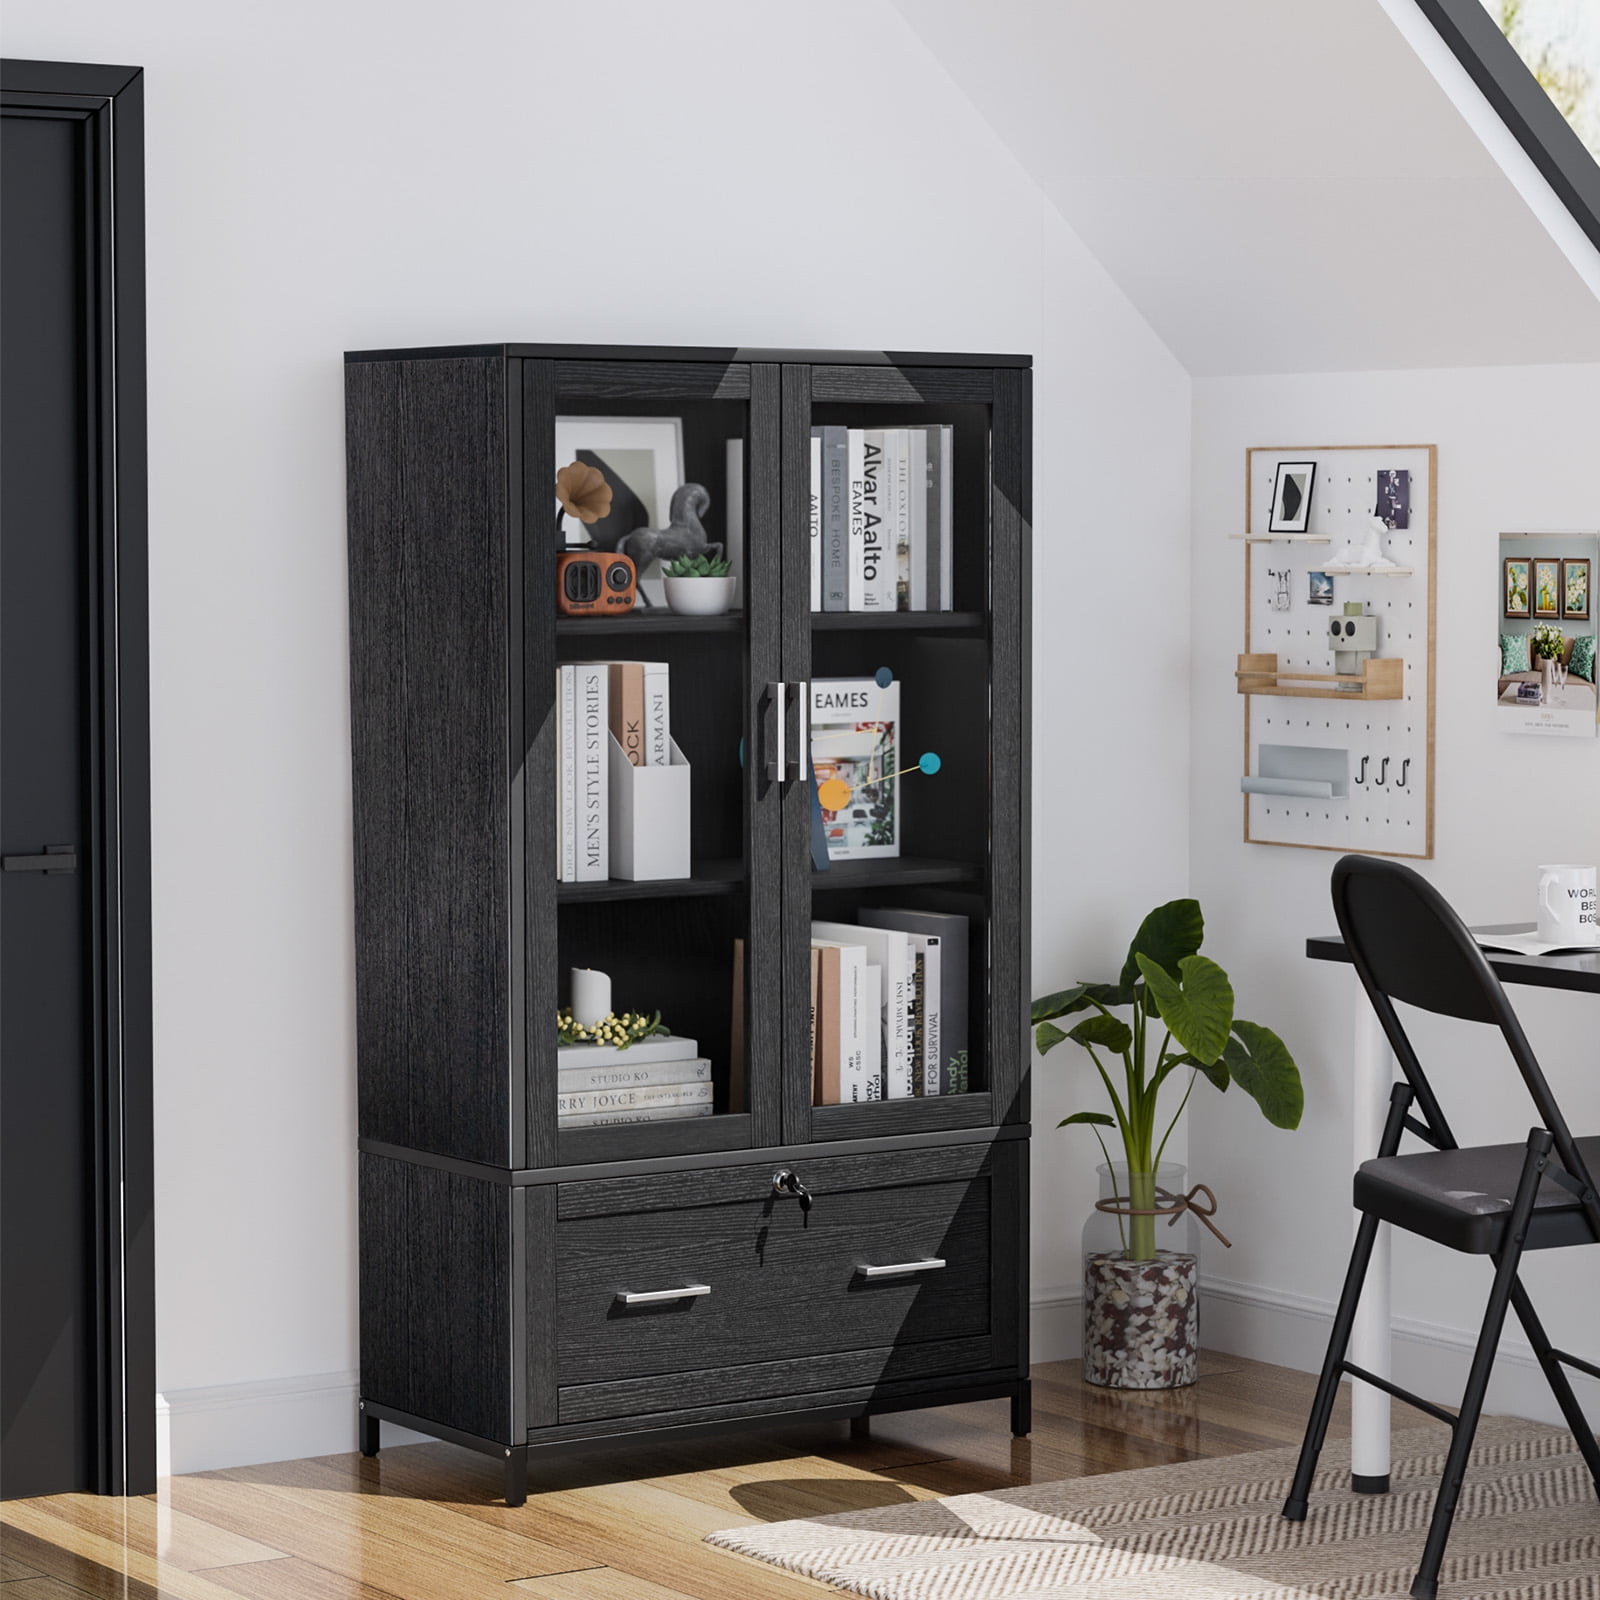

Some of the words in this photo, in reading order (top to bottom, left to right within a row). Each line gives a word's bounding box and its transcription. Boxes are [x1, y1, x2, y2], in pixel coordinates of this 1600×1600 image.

[831, 459, 841, 521] BESPOKE
[864, 443, 882, 506] Alvar
[899, 459, 907, 486] THE
[852, 480, 863, 536] EAMES
[831, 529, 841, 568] HOME
[864, 512, 882, 581] Aalto
[586, 675, 600, 751] STORIES
[815, 692, 869, 709] EAMES
[653, 693, 664, 766] ARMANI
[565, 766, 574, 801] LOOK
[586, 754, 600, 809] STYLE
[586, 814, 600, 868] MEN'S
[928, 1012, 939, 1060] SURVIVAL
[591, 1073, 631, 1085] STUDIO
[633, 1071, 649, 1081] KO
[866, 1080, 874, 1102] ndy
[928, 1063, 938, 1085] FOR
[957, 1049, 969, 1093] arhol
[559, 1096, 586, 1110] RRY
[593, 1092, 636, 1108] JOYCE
